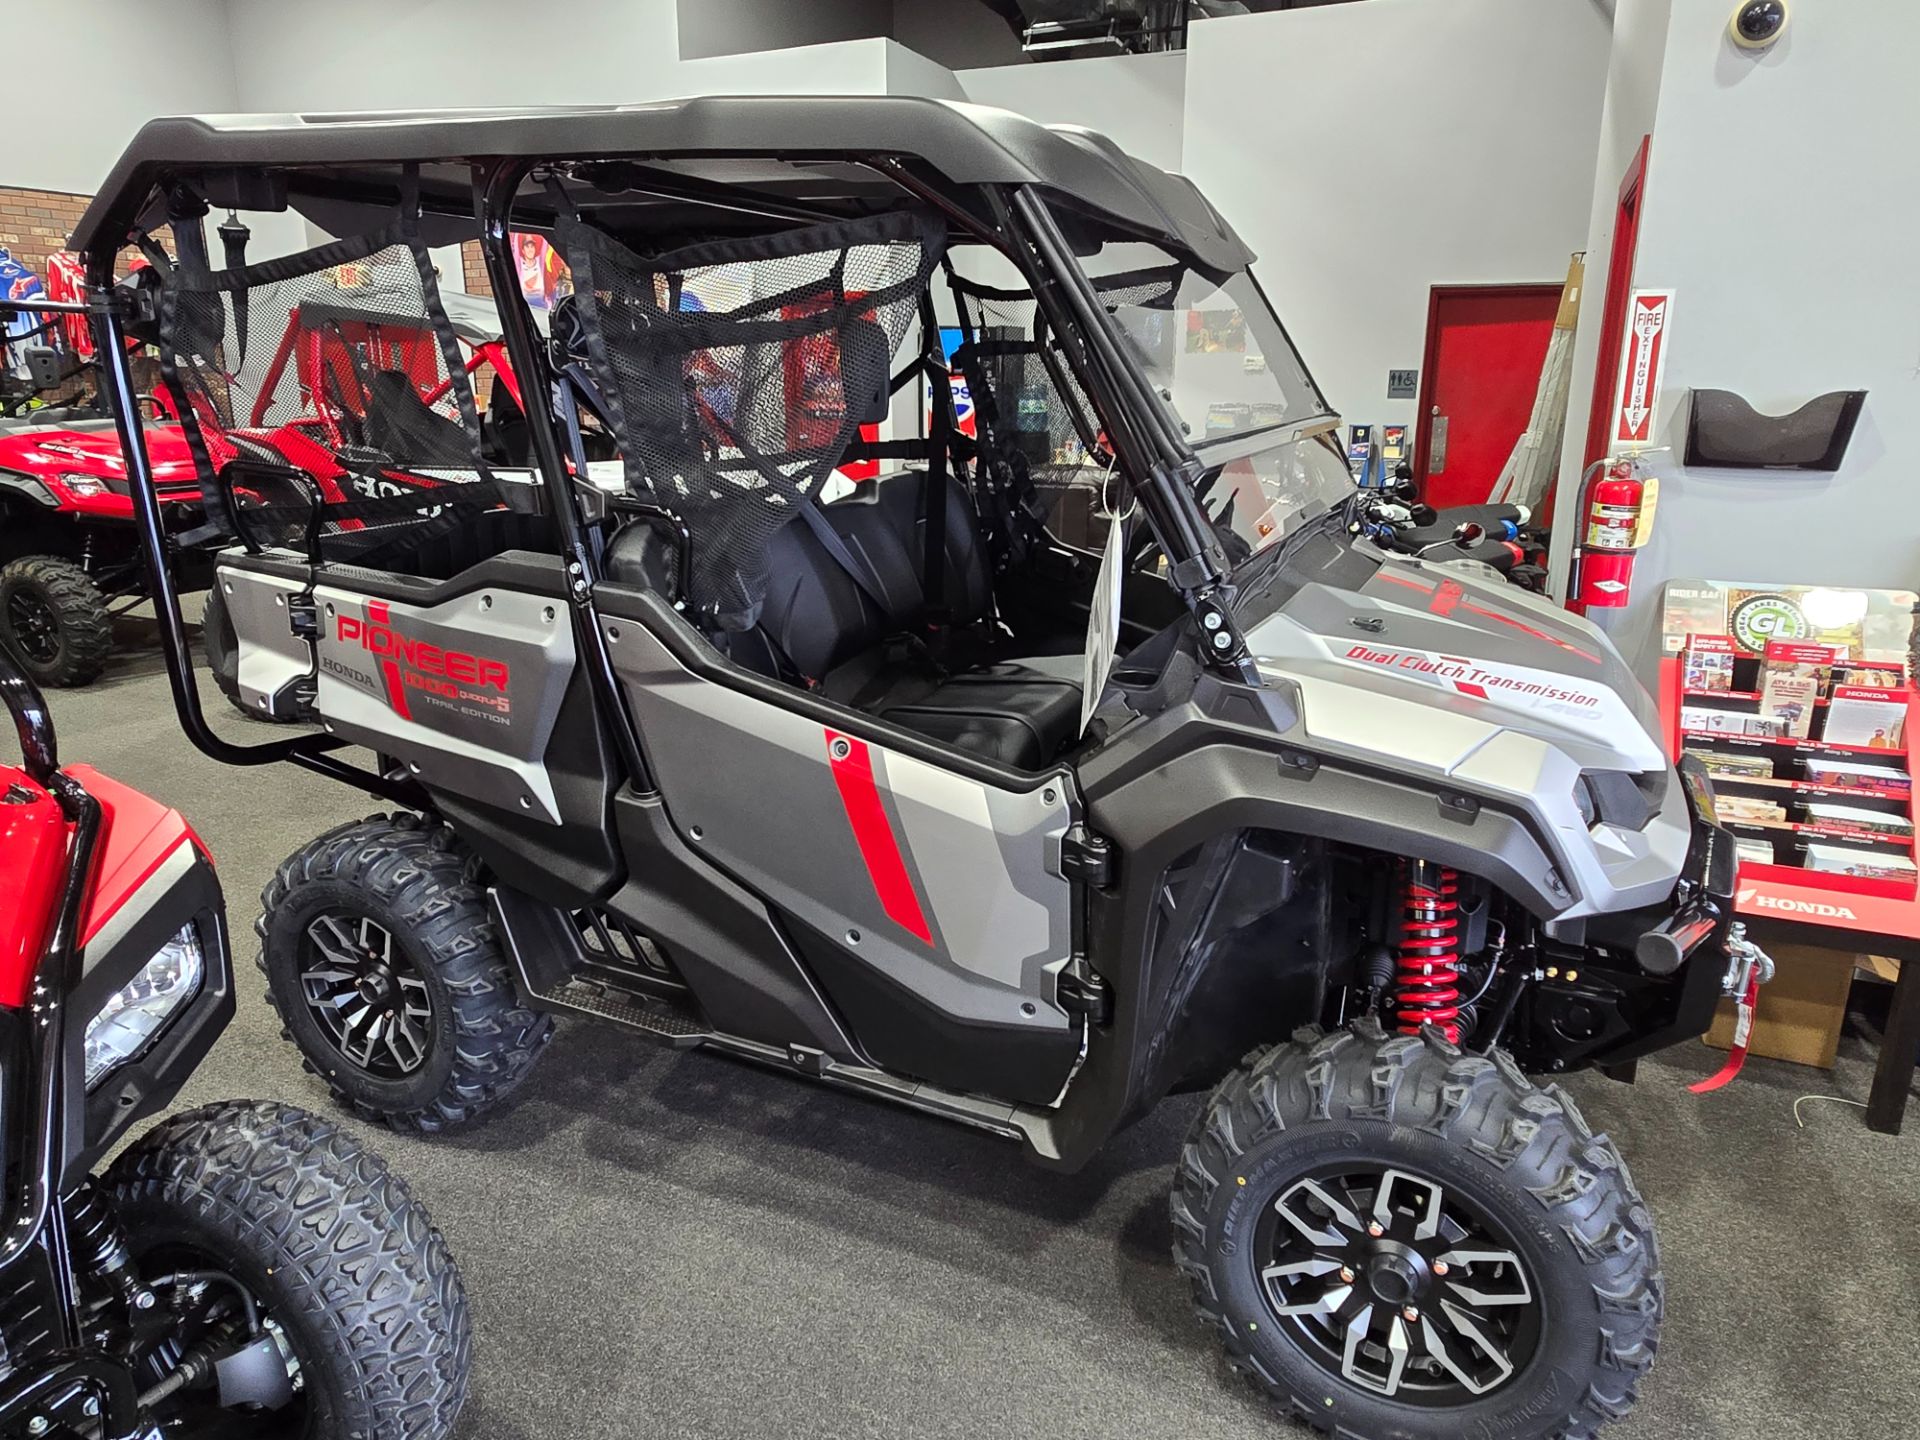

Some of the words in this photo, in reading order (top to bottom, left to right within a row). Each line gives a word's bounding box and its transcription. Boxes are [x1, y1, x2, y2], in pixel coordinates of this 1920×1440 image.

[1637, 313, 1661, 326] FIRE
[1631, 327, 1651, 427] EXTINGUISHER
[1669, 588, 1698, 599] RIDER
[1701, 589, 1723, 599] SAF
[1739, 611, 1748, 636] GREAT
[1749, 601, 1777, 611] LAKES
[1749, 613, 1791, 637] GL
[337, 614, 509, 693] PIONEER
[322, 657, 376, 689] HONDA
[404, 671, 459, 699] 1000
[1344, 645, 1398, 665] Dual
[1398, 655, 1465, 678] Clutch
[1467, 668, 1600, 707] Transmission
[1845, 691, 1890, 699] HONDA
[424, 695, 458, 712] TRAIL
[461, 706, 511, 726] EDITION
[1755, 896, 1857, 920] HONDA
